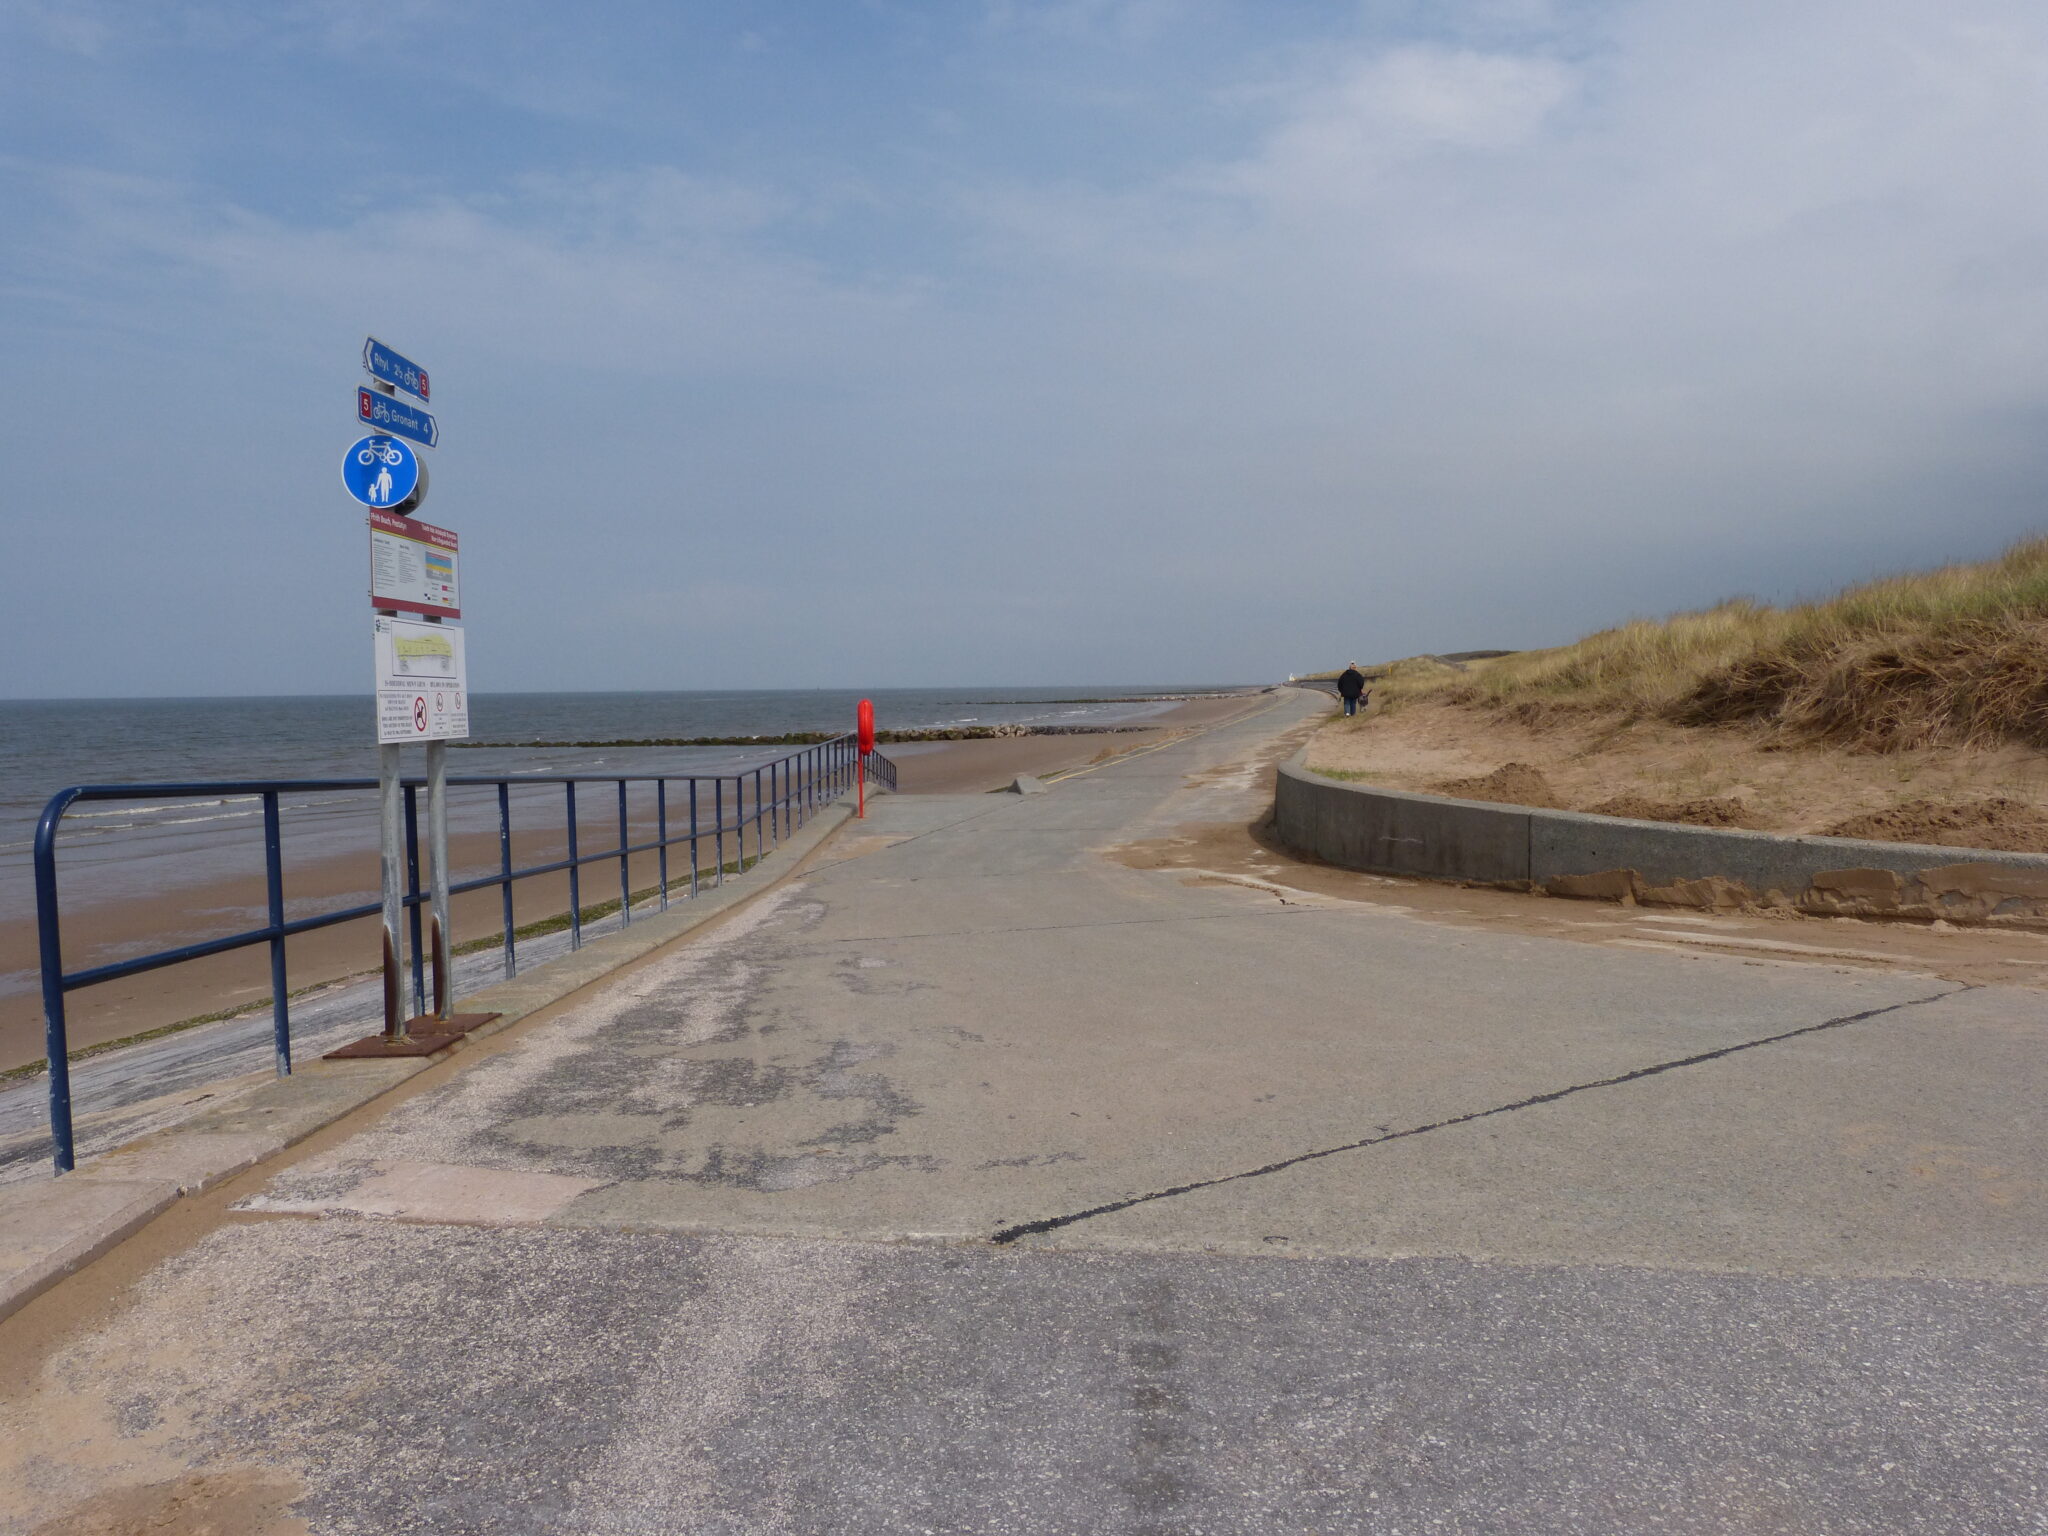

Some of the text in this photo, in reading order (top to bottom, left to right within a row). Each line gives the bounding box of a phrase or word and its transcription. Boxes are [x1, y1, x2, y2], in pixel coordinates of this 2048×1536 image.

[374, 353, 389, 371] Rhyl
[363, 398, 369, 411] 5
[391, 409, 429, 434] Gronant 4
